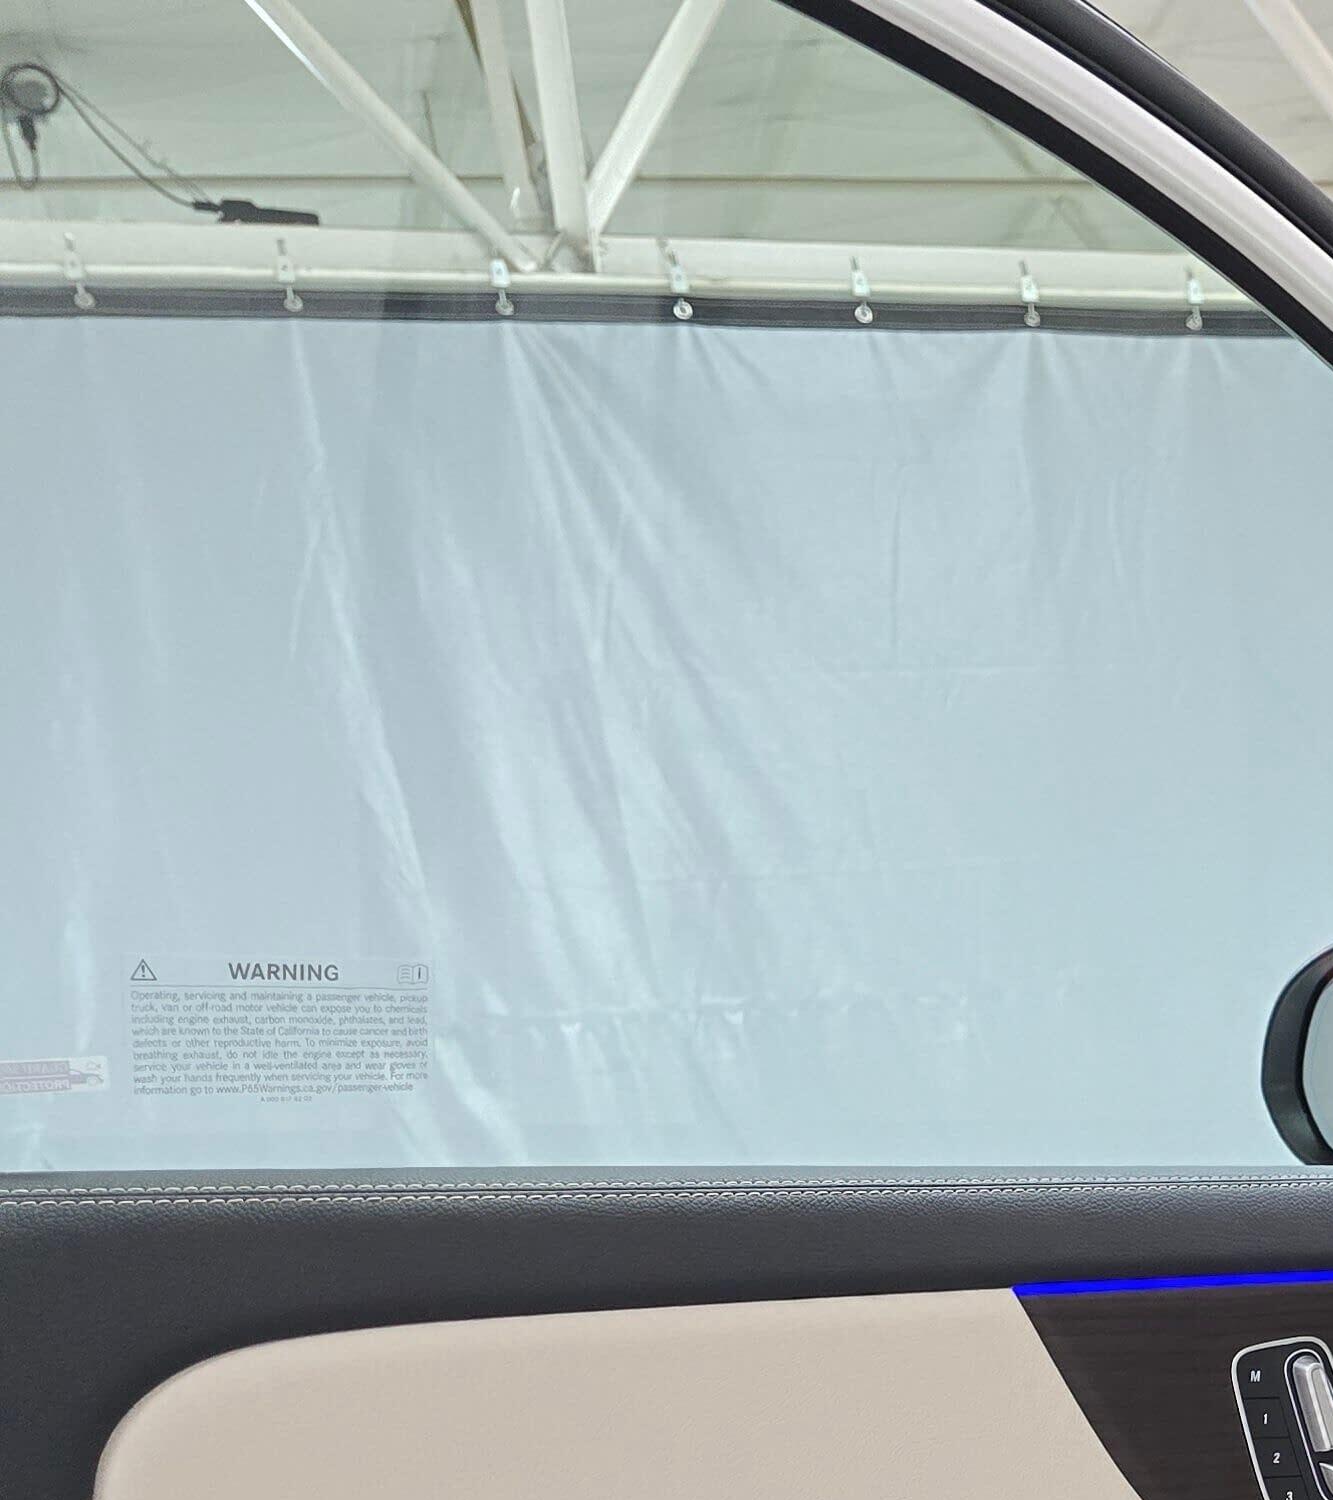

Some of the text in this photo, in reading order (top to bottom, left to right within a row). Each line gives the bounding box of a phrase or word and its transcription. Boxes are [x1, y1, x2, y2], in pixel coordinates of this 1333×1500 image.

[227, 962, 339, 981] WARNING
[130, 991, 180, 1002] Operating,
[184, 992, 225, 1002] servicing
[229, 992, 247, 1001] and
[251, 992, 304, 1003] maintaining
[316, 995, 361, 1003] passenger
[364, 993, 396, 1003] vehicle,
[131, 1002, 158, 1013] truck,
[196, 1002, 232, 1011] off-road
[236, 1003, 263, 1012] motor
[266, 1003, 298, 1012] vehicle
[320, 1005, 352, 1014] expose
[355, 1005, 371, 1014] you
[374, 1003, 382, 1012] to
[178, 1014, 209, 1025] engine
[213, 1014, 252, 1025] exhaust,
[255, 1015, 286, 1024] carbon
[389, 1015, 404, 1025] and
[179, 1026, 210, 1035] known
[212, 1026, 221, 1035] to
[224, 1026, 238, 1035] the
[241, 1026, 265, 1035] State
[267, 1026, 276, 1035] of
[278, 1026, 320, 1035] California
[322, 1026, 331, 1035] to
[391, 1027, 407, 1036] and
[171, 1040, 181, 1048] or
[185, 1038, 210, 1048] other
[214, 1038, 272, 1049] reproductive
[305, 1038, 316, 1048] To
[226, 1050, 238, 1059] do
[243, 1050, 257, 1059] not
[262, 1050, 279, 1059] idle
[283, 1050, 298, 1059] the
[303, 1050, 332, 1060] engine
[335, 1050, 365, 1060] except
[171, 1064, 192, 1072] your
[196, 1062, 229, 1071] vehicle
[232, 1062, 241, 1071] in
[253, 1062, 318, 1071] well-ventilated
[345, 1062, 361, 1071] and
[161, 1075, 181, 1084] your
[184, 1073, 213, 1082] hands
[216, 1073, 261, 1083] frequently
[264, 1073, 288, 1082] when
[291, 1073, 332, 1083] servicing
[334, 1074, 353, 1083] your
[390, 1072, 404, 1081] For
[134, 1085, 188, 1094] information
[190, 1087, 202, 1095] go
[204, 1085, 214, 1094] to
[1250, 1370, 1262, 1383] M
[1263, 1413, 1269, 1425] 1
[1273, 1452, 1281, 1464] 2
